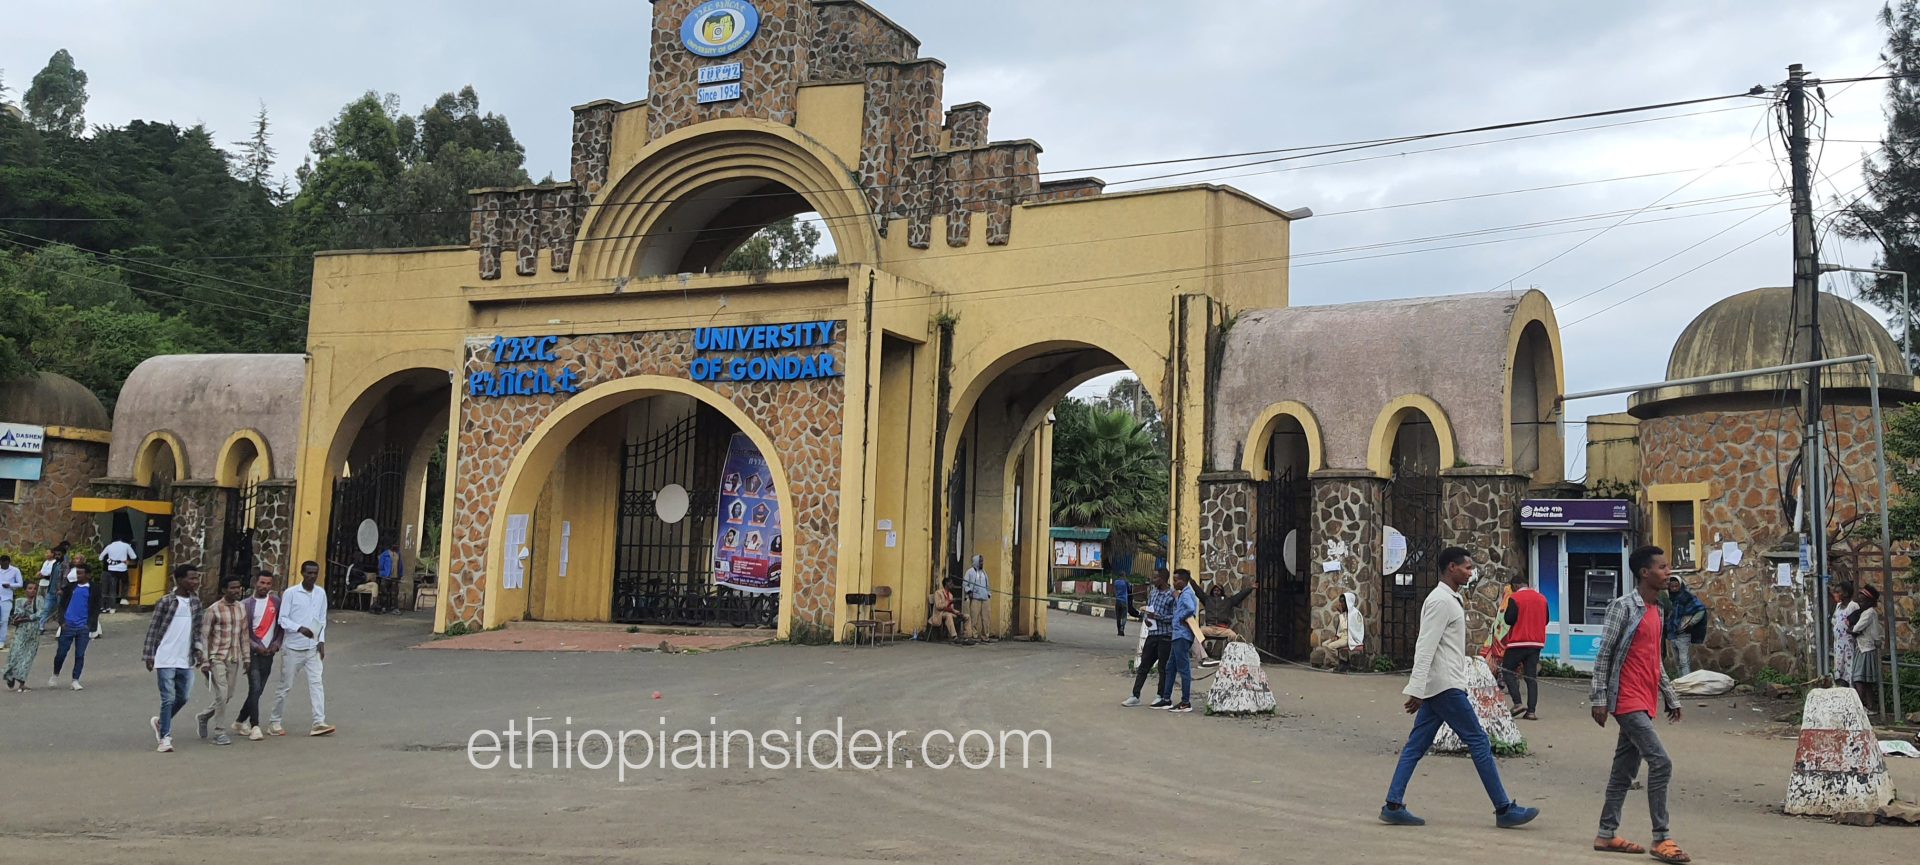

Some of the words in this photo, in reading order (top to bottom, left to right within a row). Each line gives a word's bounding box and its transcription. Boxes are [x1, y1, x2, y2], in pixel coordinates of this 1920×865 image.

[687, 39, 717, 54] UNIVERSITY
[698, 86, 718, 102] Since
[720, 84, 738, 100] 1954
[489, 335, 558, 363] ጎንደር
[693, 321, 834, 351] UNIVERSITY
[469, 367, 577, 397] ዩኒቨርሲቲ
[690, 358, 723, 382] OF
[728, 354, 834, 382] GONDAR
[16, 432, 42, 440] DASHEN
